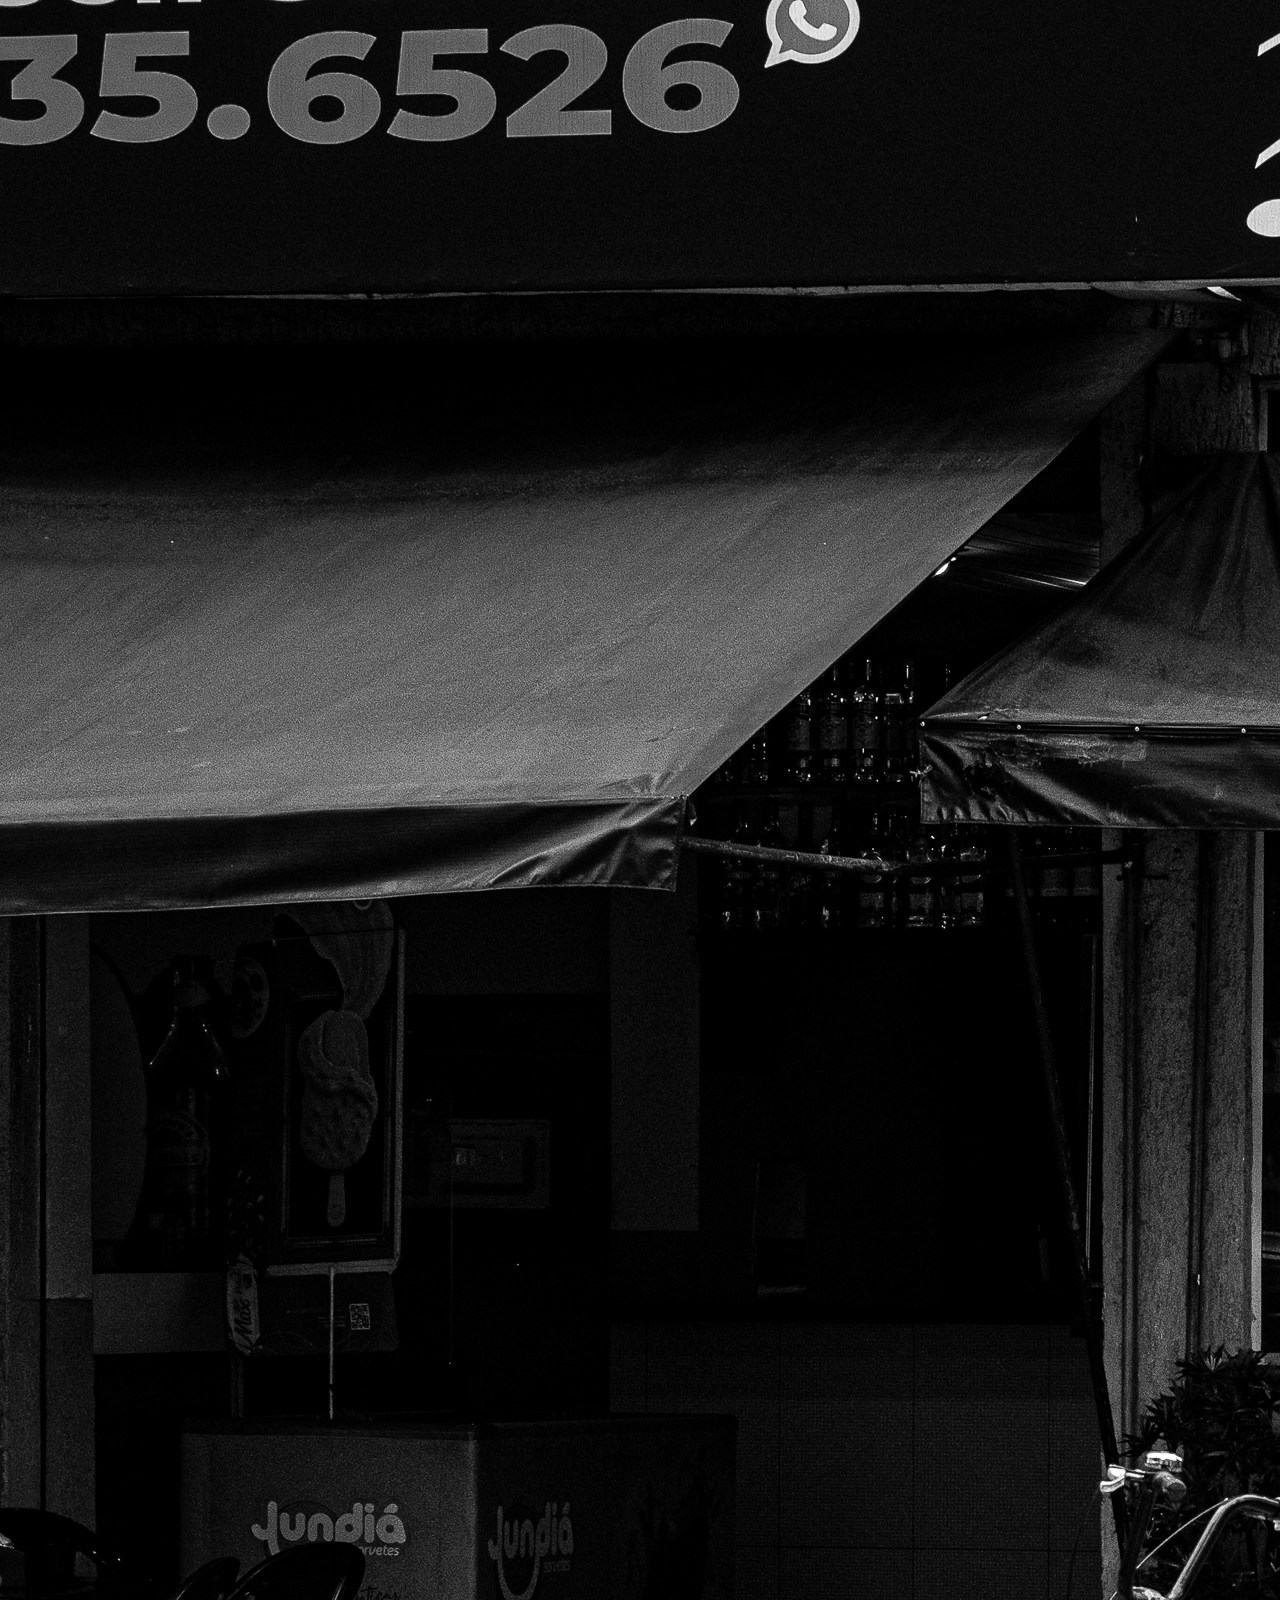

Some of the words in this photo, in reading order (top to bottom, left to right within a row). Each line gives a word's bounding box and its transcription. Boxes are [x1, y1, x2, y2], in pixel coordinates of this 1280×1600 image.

[0, 18, 740, 145] 35.6526
[250, 1500, 407, 1555] Jundiá
[487, 1500, 575, 1560] Jundiá
